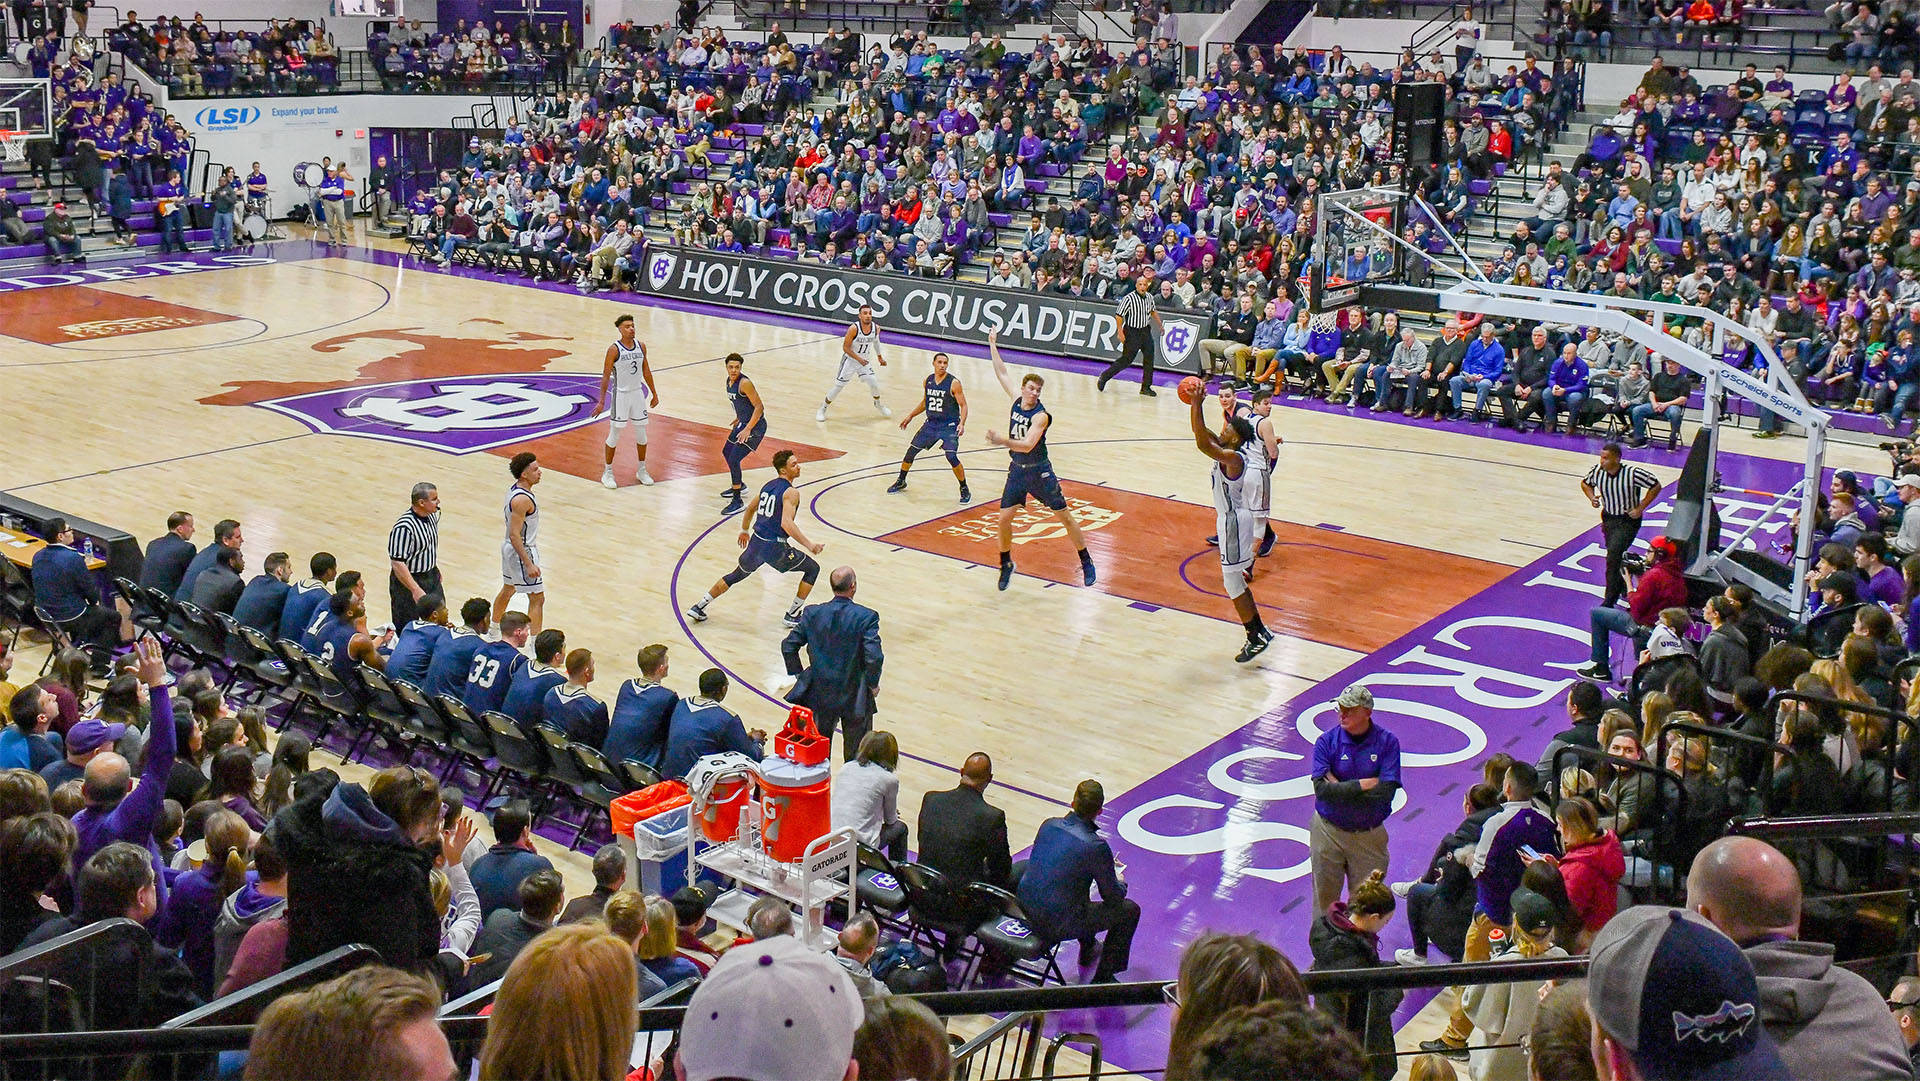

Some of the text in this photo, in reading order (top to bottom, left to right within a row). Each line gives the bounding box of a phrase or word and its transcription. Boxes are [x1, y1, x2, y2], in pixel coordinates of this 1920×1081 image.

[207, 108, 249, 124] LSI
[272, 105, 339, 118] Expand your brand.
[1808, 150, 1820, 164] K
[678, 258, 1123, 352] HOLY CROSS CRUSADER
[857, 343, 869, 353] 11
[630, 361, 638, 375] 3
[926, 388, 946, 397] NAVY
[928, 397, 944, 412] 22
[1769, 394, 1804, 416] Sports
[1011, 411, 1030, 426] NAVY
[1011, 423, 1028, 440] 40
[757, 491, 776, 518] 20
[307, 610, 329, 637] 1
[320, 641, 335, 660] 2
[467, 653, 500, 689] 33
[785, 743, 796, 757] G
[762, 796, 776, 820] G
[811, 850, 849, 874] GATORADE
